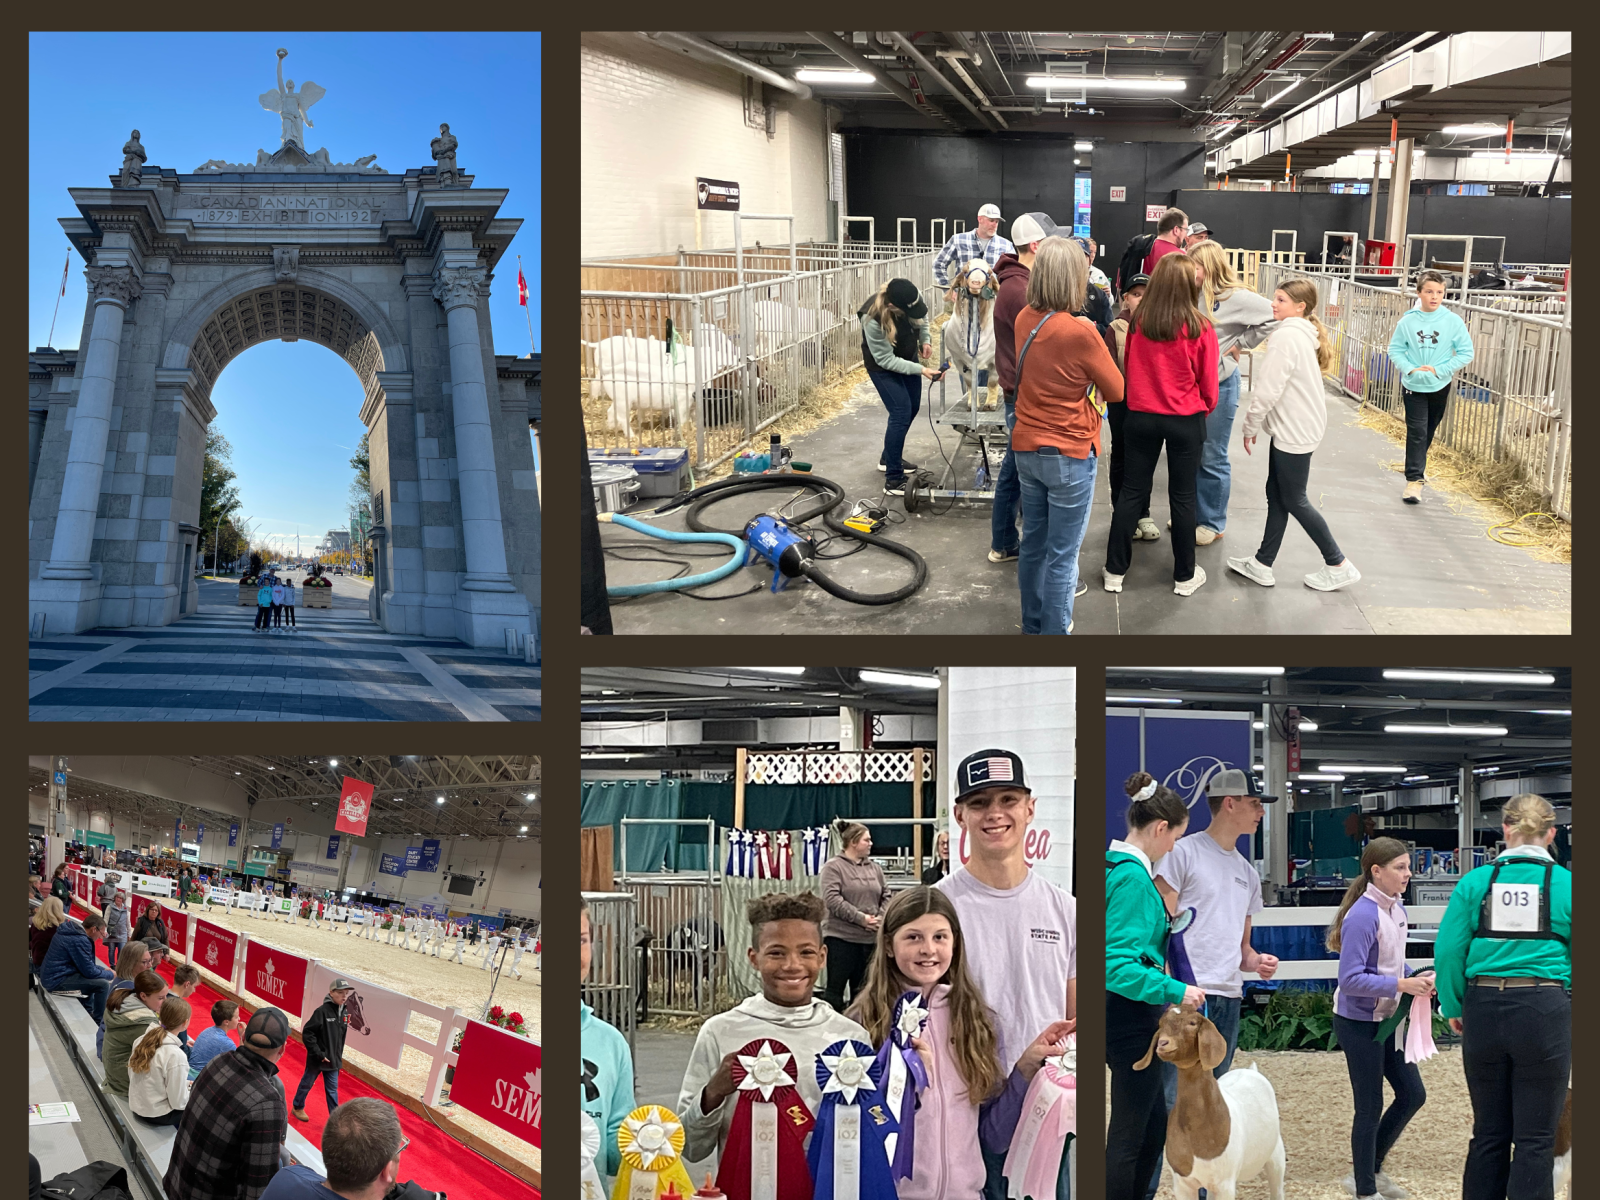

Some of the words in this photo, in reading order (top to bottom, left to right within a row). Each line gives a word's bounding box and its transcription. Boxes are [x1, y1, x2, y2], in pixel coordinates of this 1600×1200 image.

[1111, 190, 1124, 198] EXIT
[201, 197, 288, 208] CANADIAN
[295, 197, 382, 208] NATIONAL
[202, 210, 233, 222] 1879
[241, 210, 338, 223] EXHIBITION
[345, 211, 381, 223] 1927
[1502, 890, 1529, 907] 013
[256, 969, 286, 999] SEMEX
[755, 1131, 775, 1142] 102
[837, 1130, 857, 1140] 102
